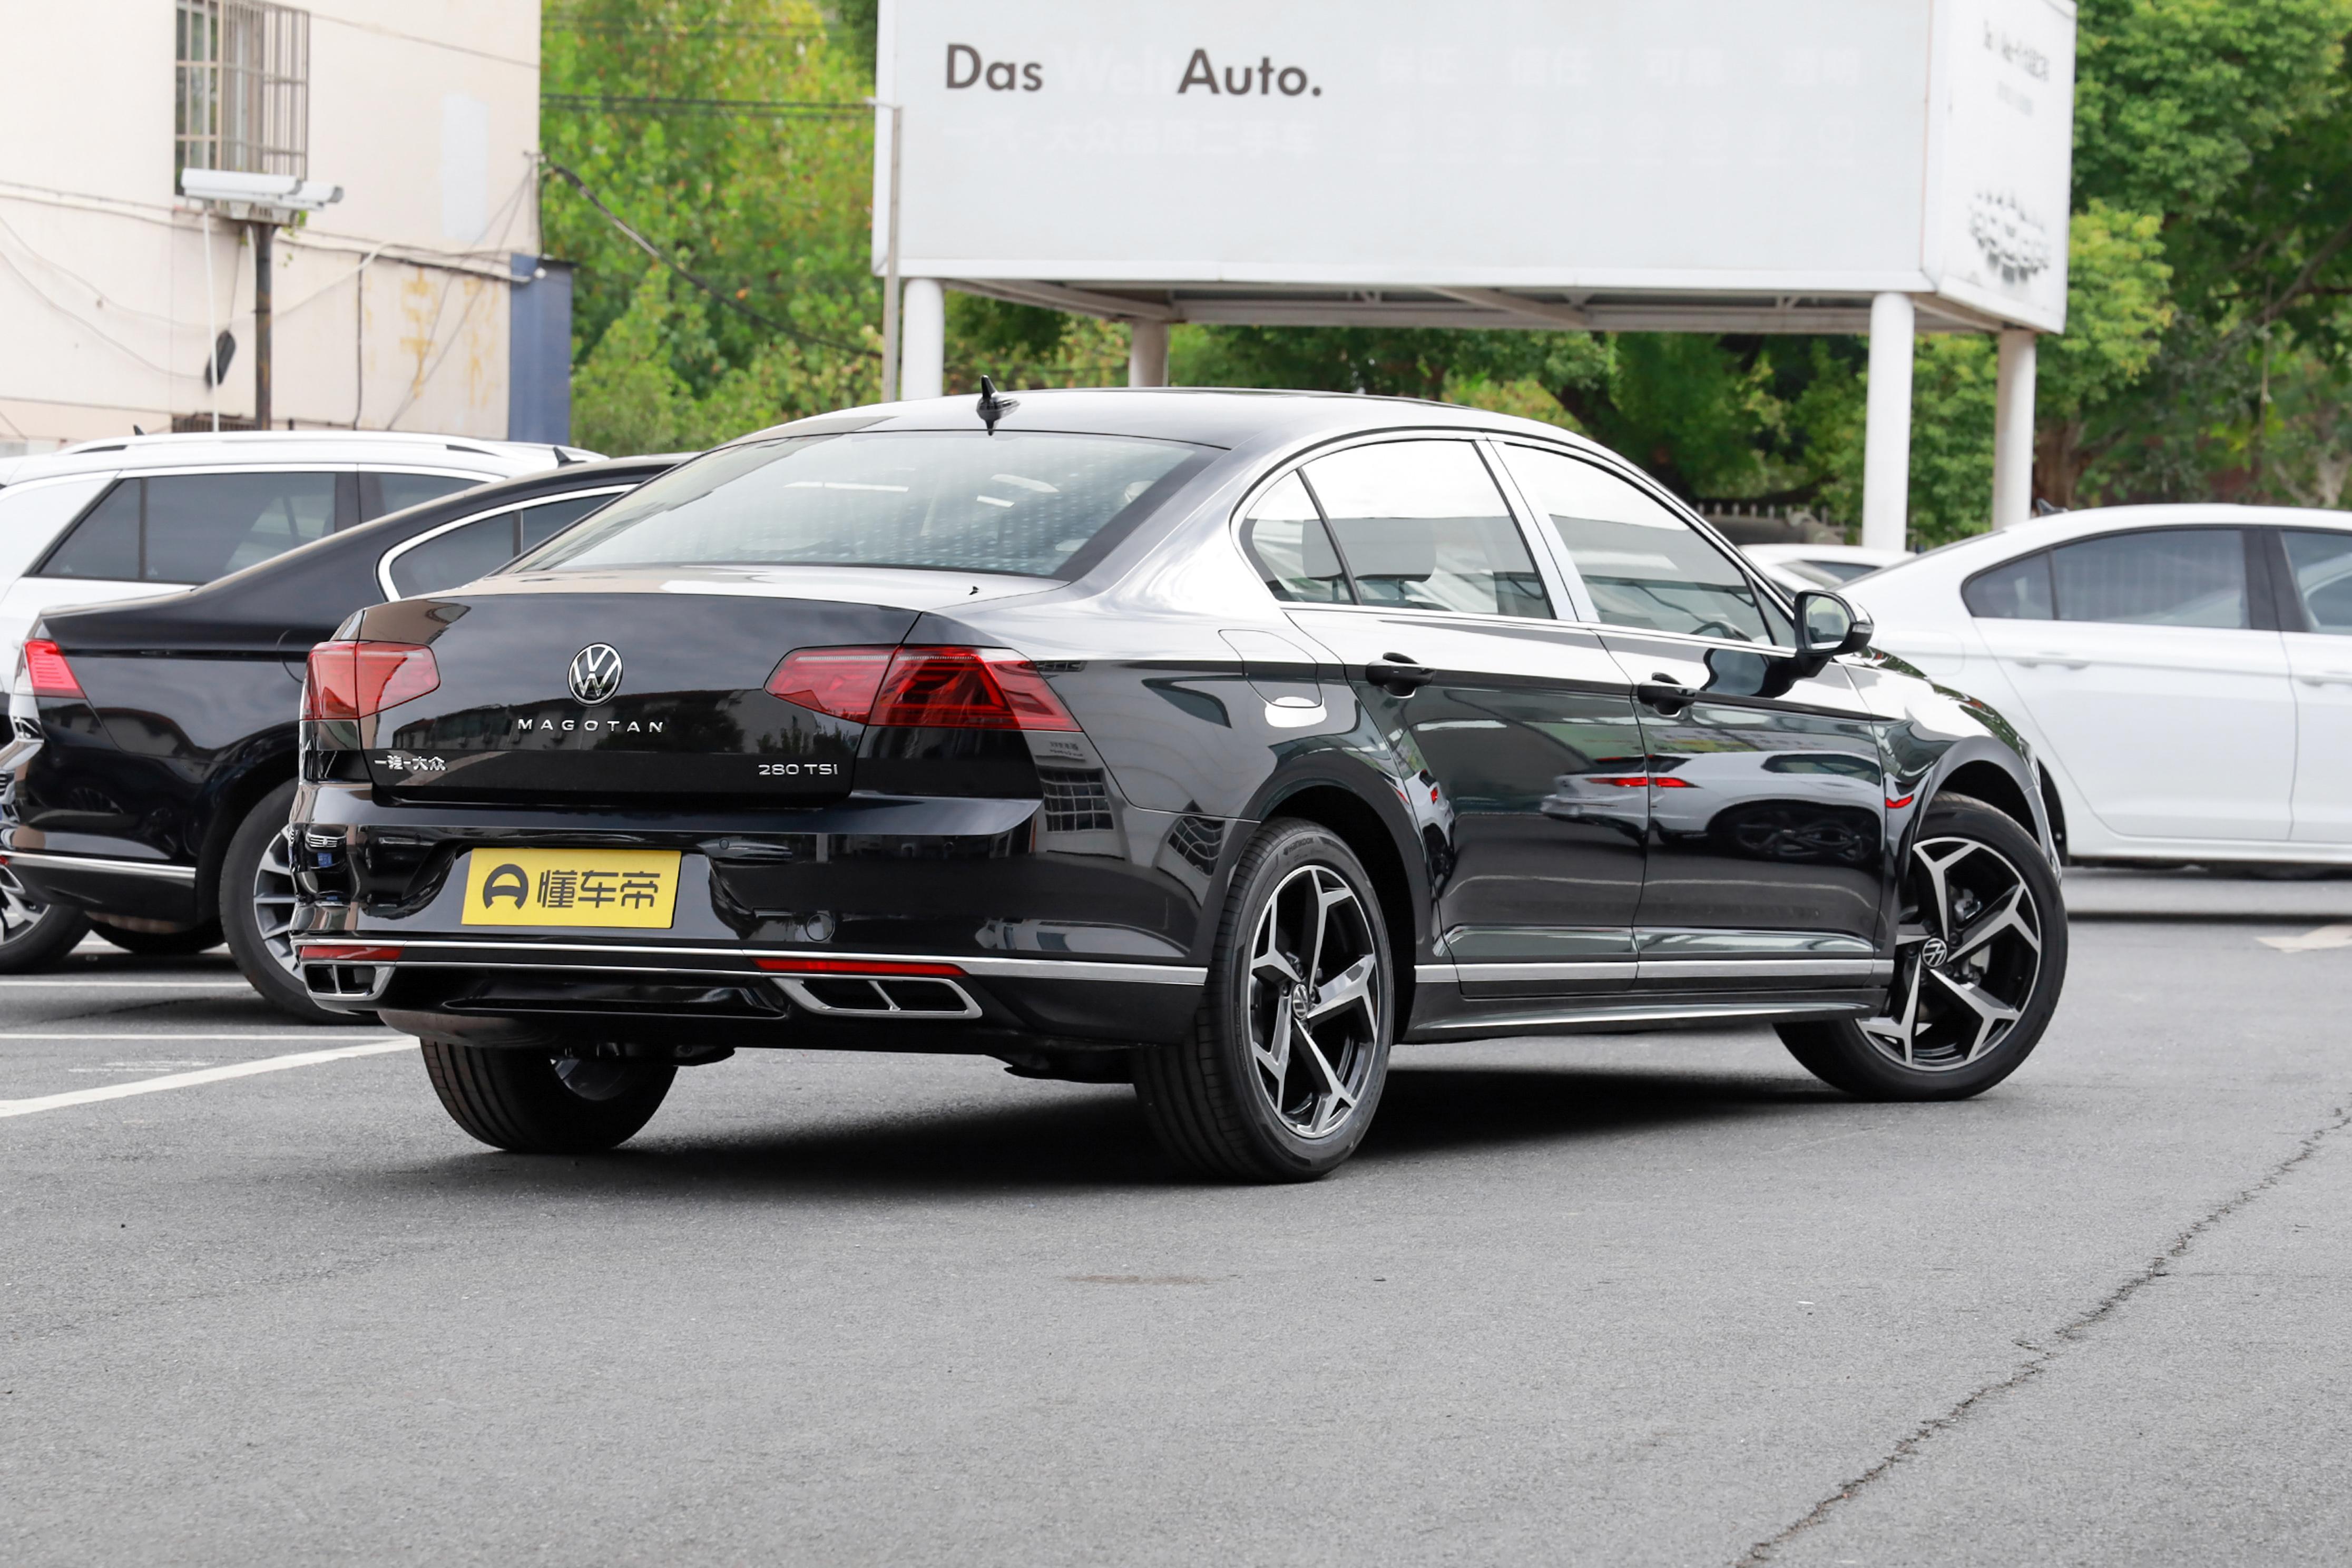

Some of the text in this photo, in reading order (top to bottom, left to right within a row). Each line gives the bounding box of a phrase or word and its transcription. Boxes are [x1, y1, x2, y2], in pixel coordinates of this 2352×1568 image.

[946, 43, 1043, 91] Das
[1177, 48, 1322, 97] Auto.
[517, 719, 663, 733] MAGOTAN
[758, 763, 838, 775] 280 TSI
[536, 869, 661, 909] 懂车帝
